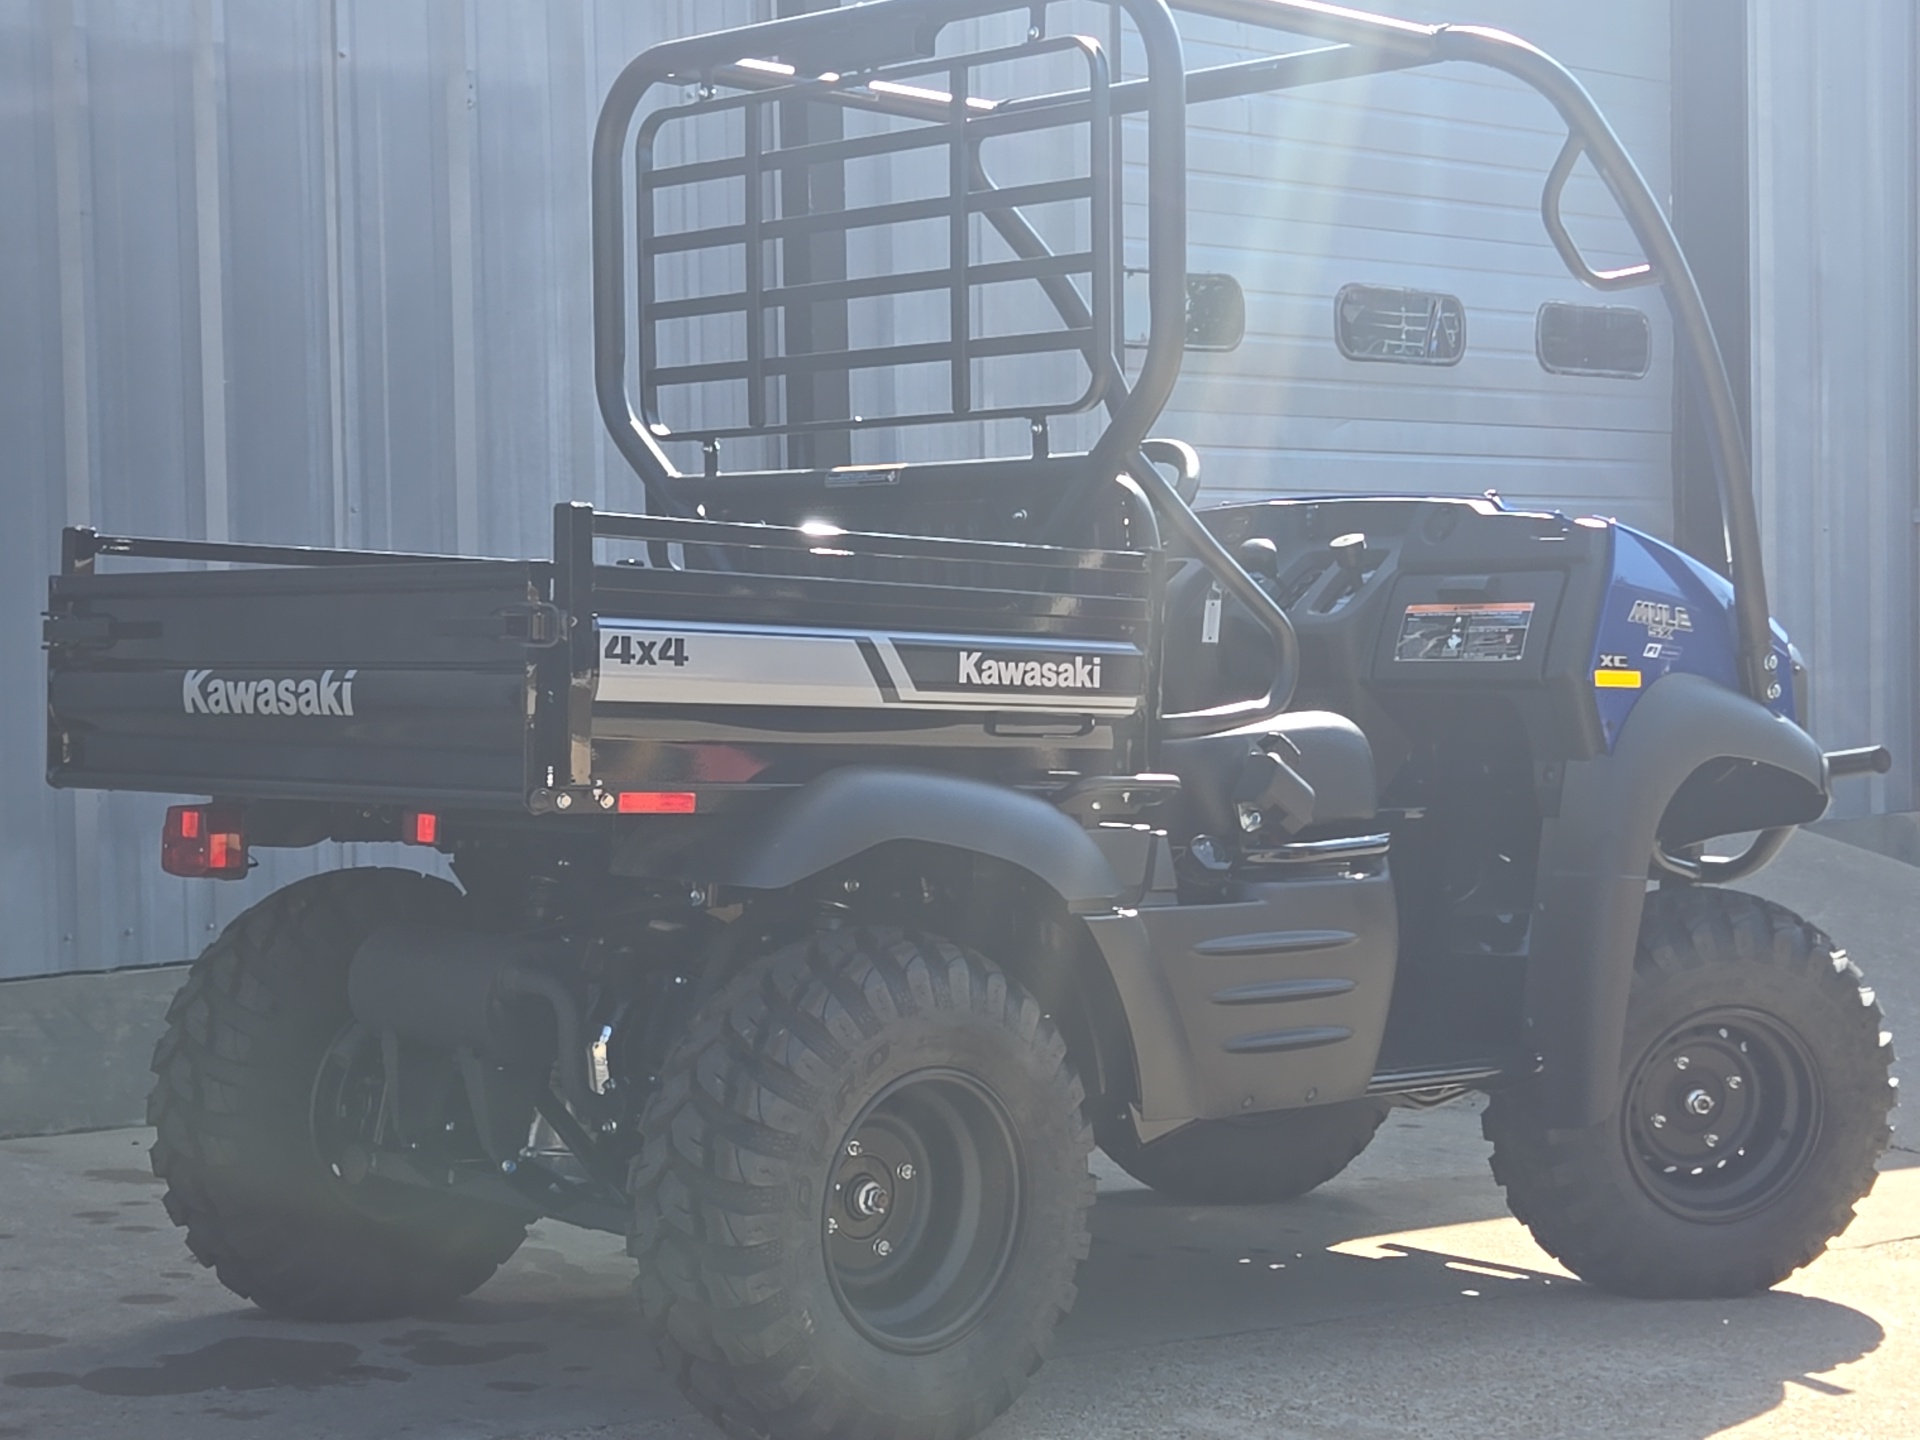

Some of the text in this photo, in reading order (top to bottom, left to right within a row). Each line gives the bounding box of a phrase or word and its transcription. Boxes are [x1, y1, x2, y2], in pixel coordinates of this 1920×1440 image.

[1627, 600, 1694, 632] MULE
[604, 635, 689, 667] 4x4
[1600, 655, 1628, 667] XC
[958, 651, 1101, 688] Kawasaki
[183, 669, 358, 716] Kawasaki
